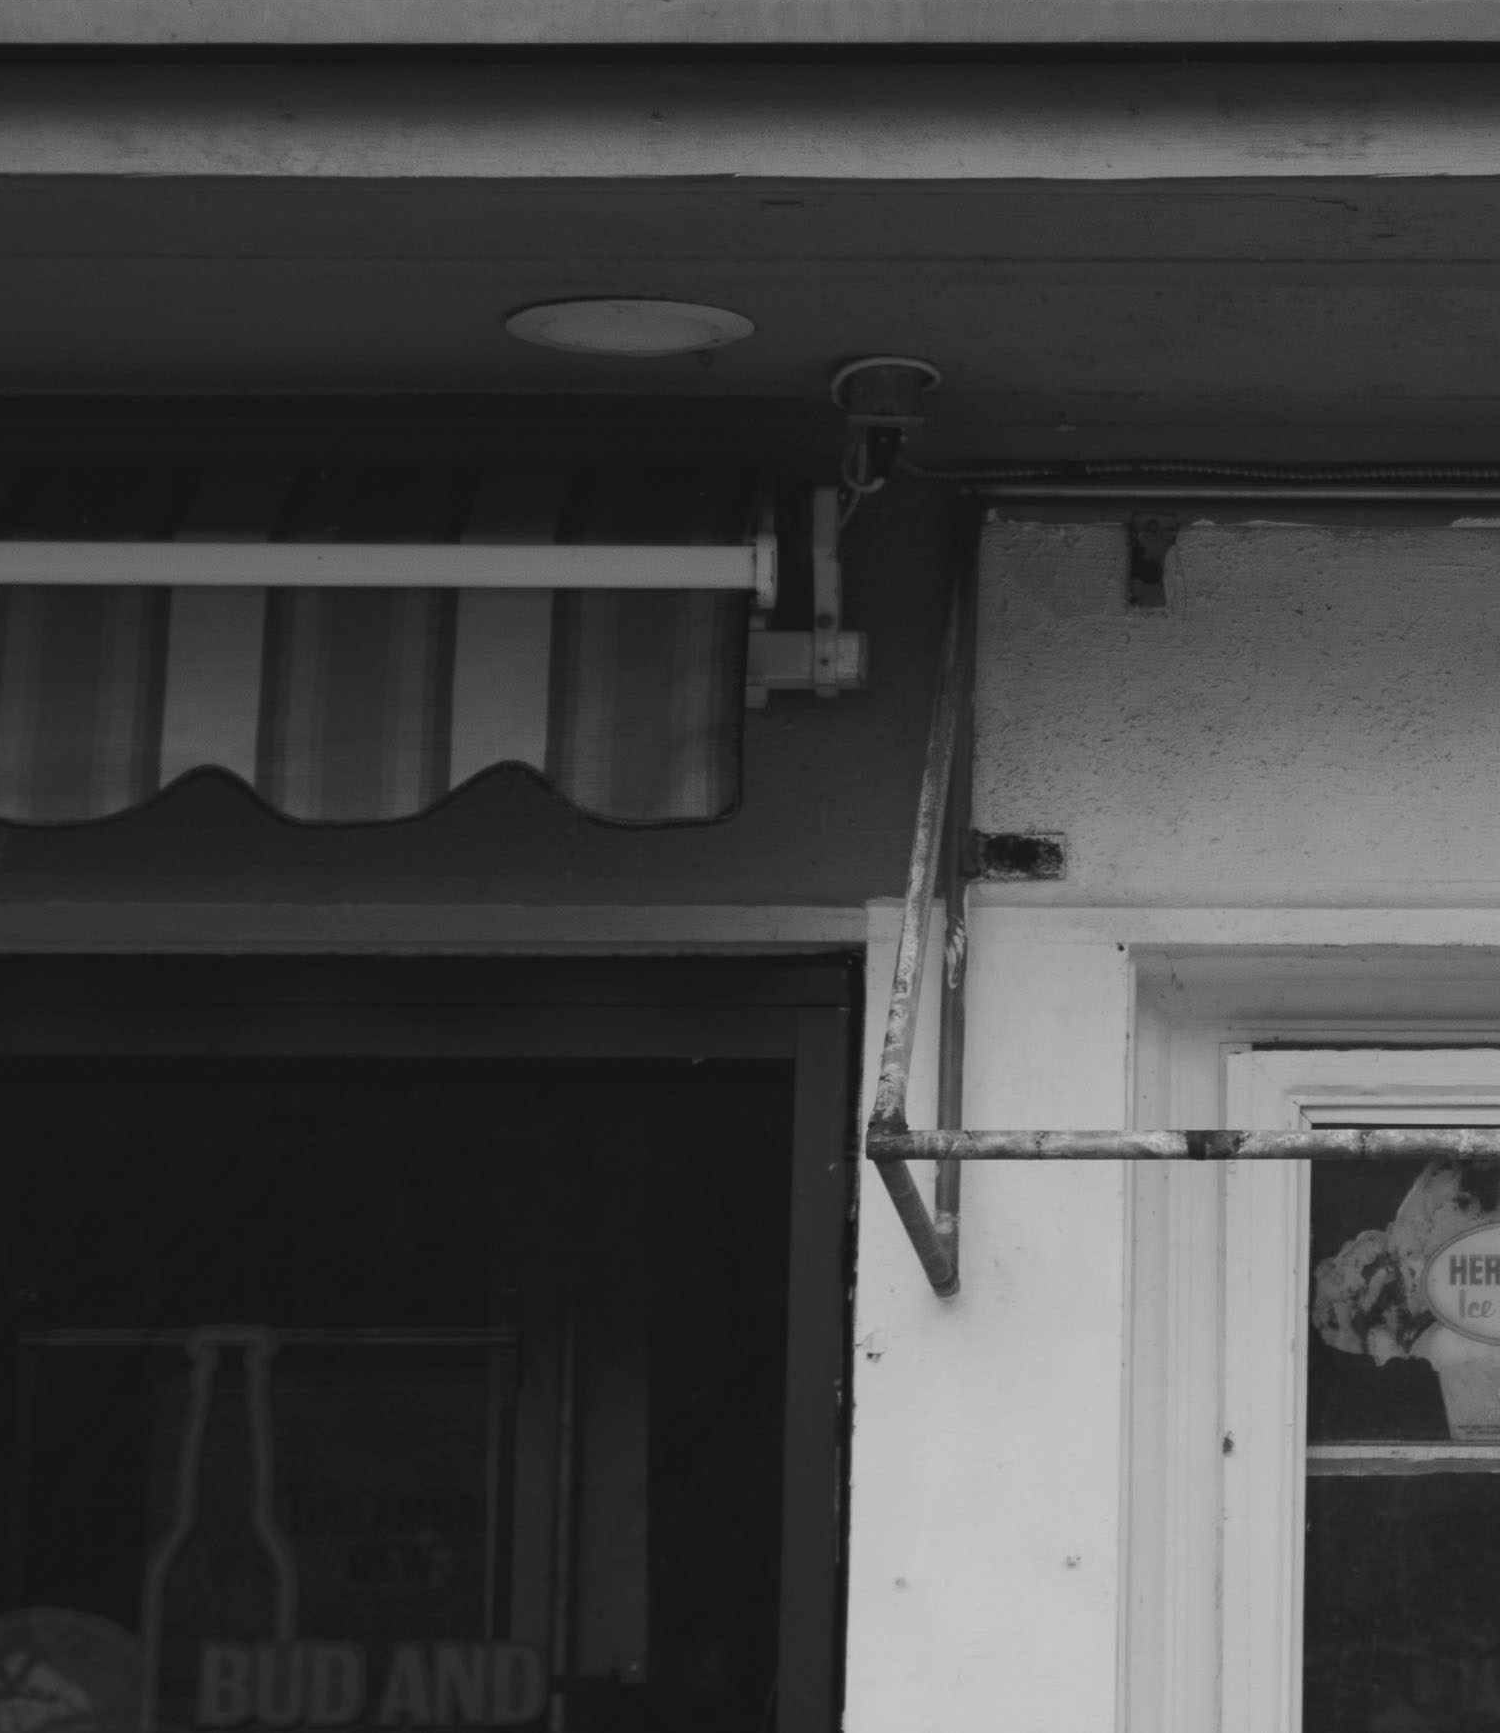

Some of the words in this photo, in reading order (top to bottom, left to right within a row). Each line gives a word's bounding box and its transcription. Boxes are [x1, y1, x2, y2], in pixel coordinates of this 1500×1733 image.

[1458, 1289, 1496, 1317] Ice
[202, 1643, 362, 1725] BUD
[380, 1642, 548, 1725] AND
